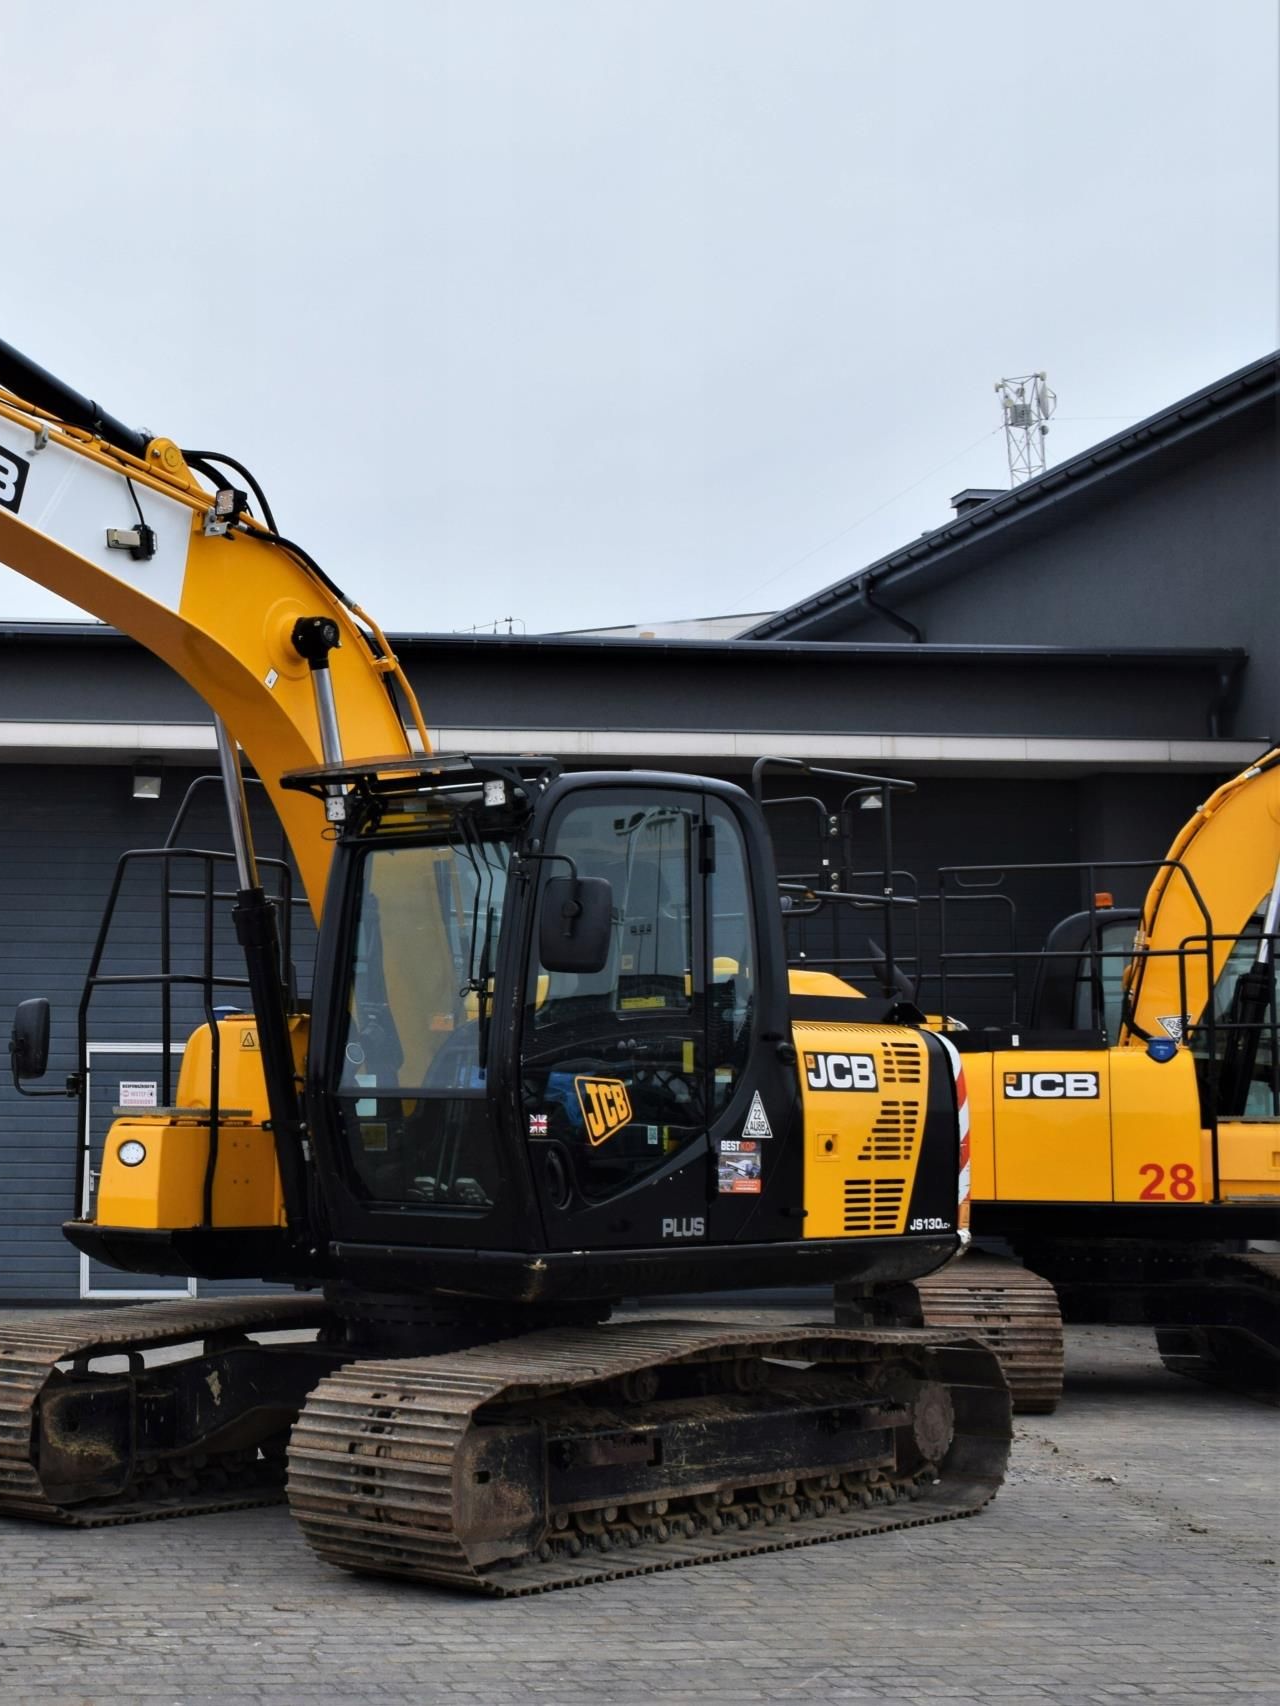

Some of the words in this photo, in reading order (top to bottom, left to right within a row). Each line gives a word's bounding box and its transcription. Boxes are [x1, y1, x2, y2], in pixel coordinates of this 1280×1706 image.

[807, 1054, 877, 1089] JCB
[1005, 1073, 1098, 1098] JCB
[585, 1083, 629, 1137] JCB
[1138, 1163, 1196, 1201] 28
[662, 1217, 704, 1238] PLUS
